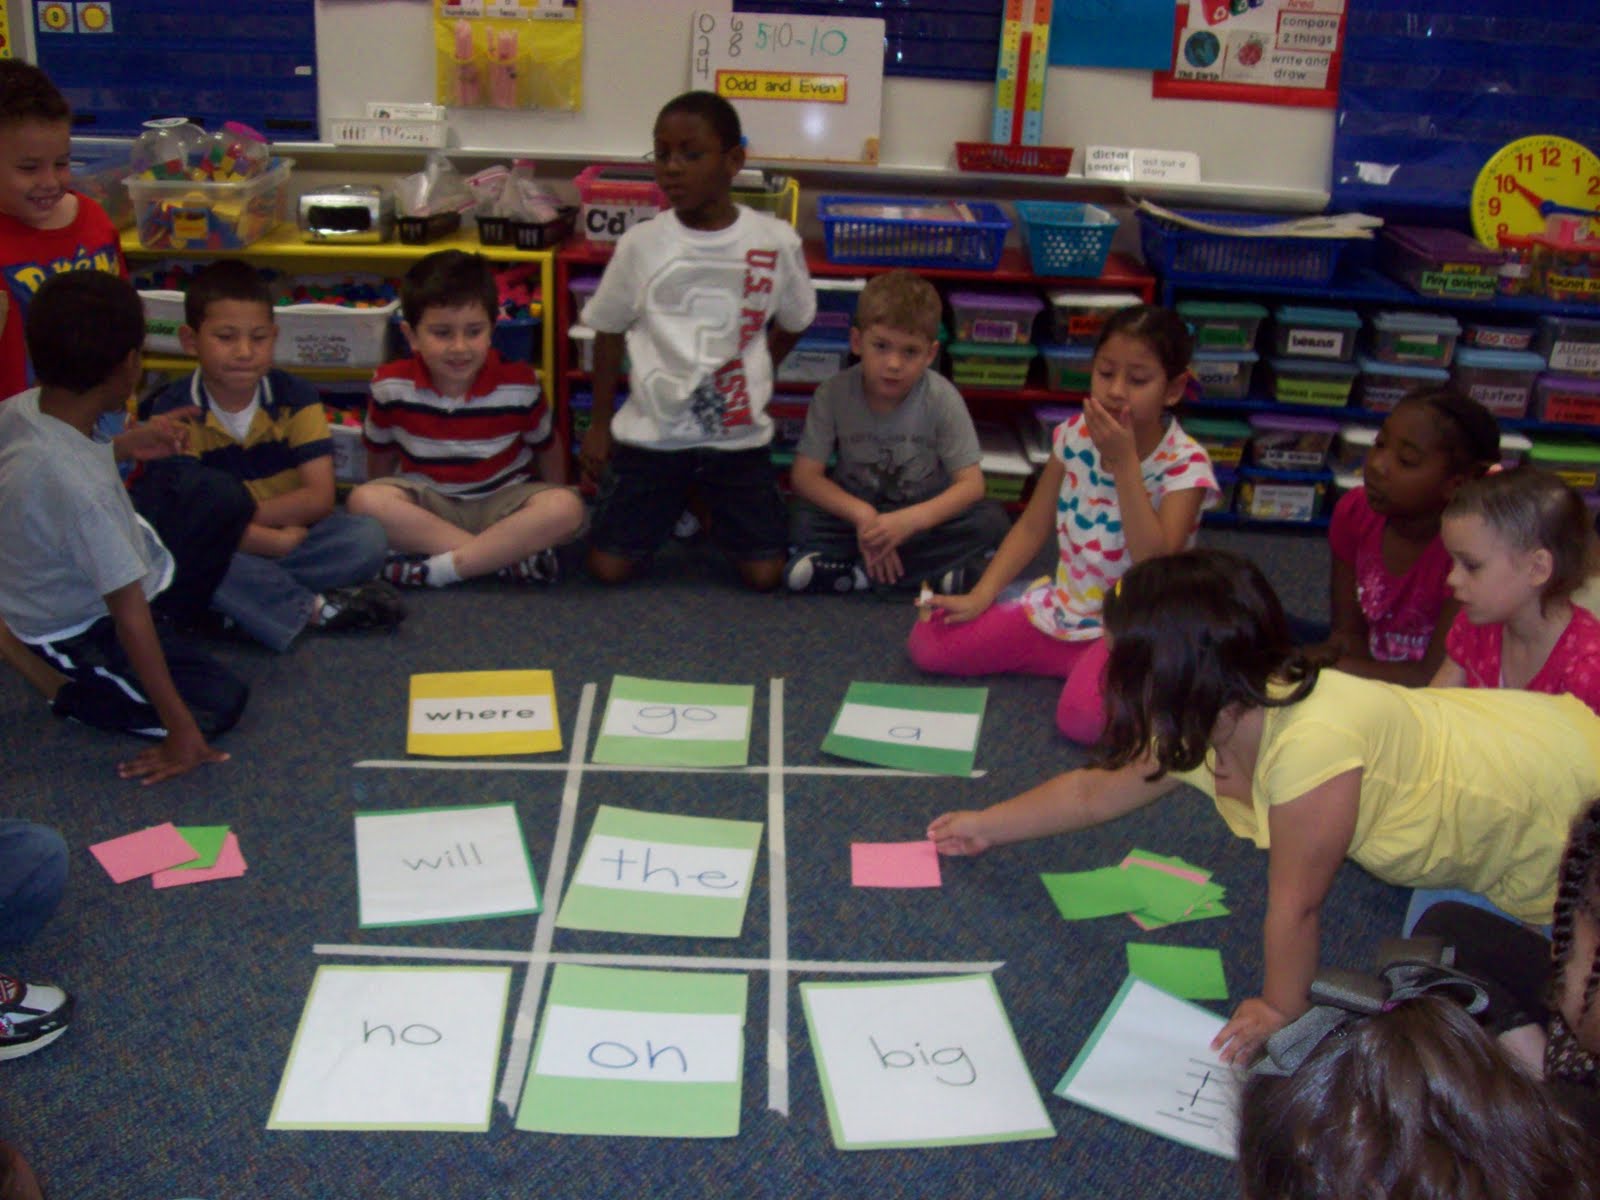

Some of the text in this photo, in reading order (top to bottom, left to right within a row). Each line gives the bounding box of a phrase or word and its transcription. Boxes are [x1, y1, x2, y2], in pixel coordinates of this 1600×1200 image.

[730, 15, 743, 32] 6
[1282, 16, 1338, 29] compare
[697, 35, 710, 57] 2
[728, 32, 743, 57] 8
[1283, 34, 1333, 46] 2 things
[696, 58, 709, 80] 4
[1271, 56, 1329, 67] write and
[1274, 70, 1307, 80] draw
[724, 77, 837, 94] Odd and Even
[1515, 153, 1533, 173] 11
[1541, 147, 1561, 167] 12
[1572, 157, 1581, 175] 1
[1494, 174, 1517, 194] 10
[1587, 176, 1600, 196] 2
[1488, 196, 1502, 217] 9
[425, 704, 535, 722] where
[632, 706, 717, 735] go
[888, 726, 922, 742] a
[403, 842, 483, 871] will
[600, 847, 739, 889] the
[363, 1020, 442, 1047] no
[588, 1040, 688, 1073] on
[869, 1036, 978, 1086] big
